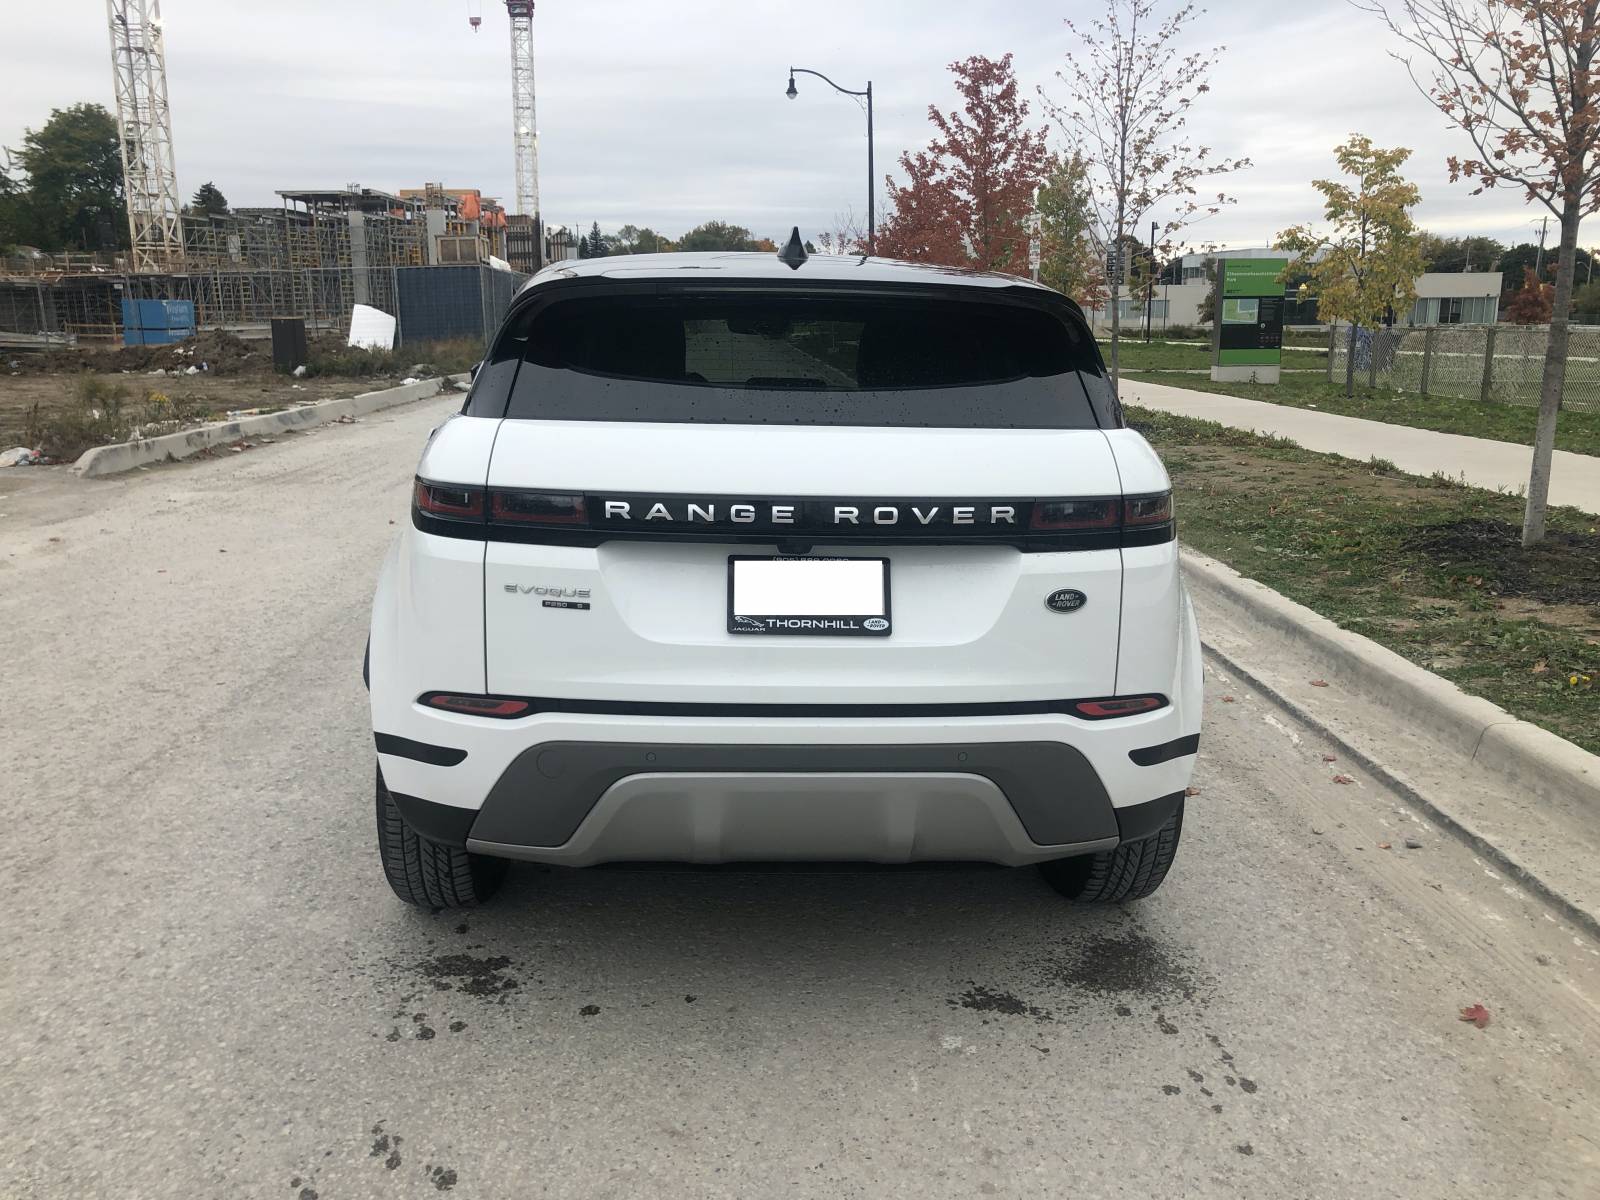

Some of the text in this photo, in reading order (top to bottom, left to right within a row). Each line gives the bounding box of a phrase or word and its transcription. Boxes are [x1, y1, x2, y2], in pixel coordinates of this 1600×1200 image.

[604, 500, 1016, 525] RANGE ROVER
[503, 584, 591, 598] EVOQUE
[765, 619, 860, 629] THORNHILL
